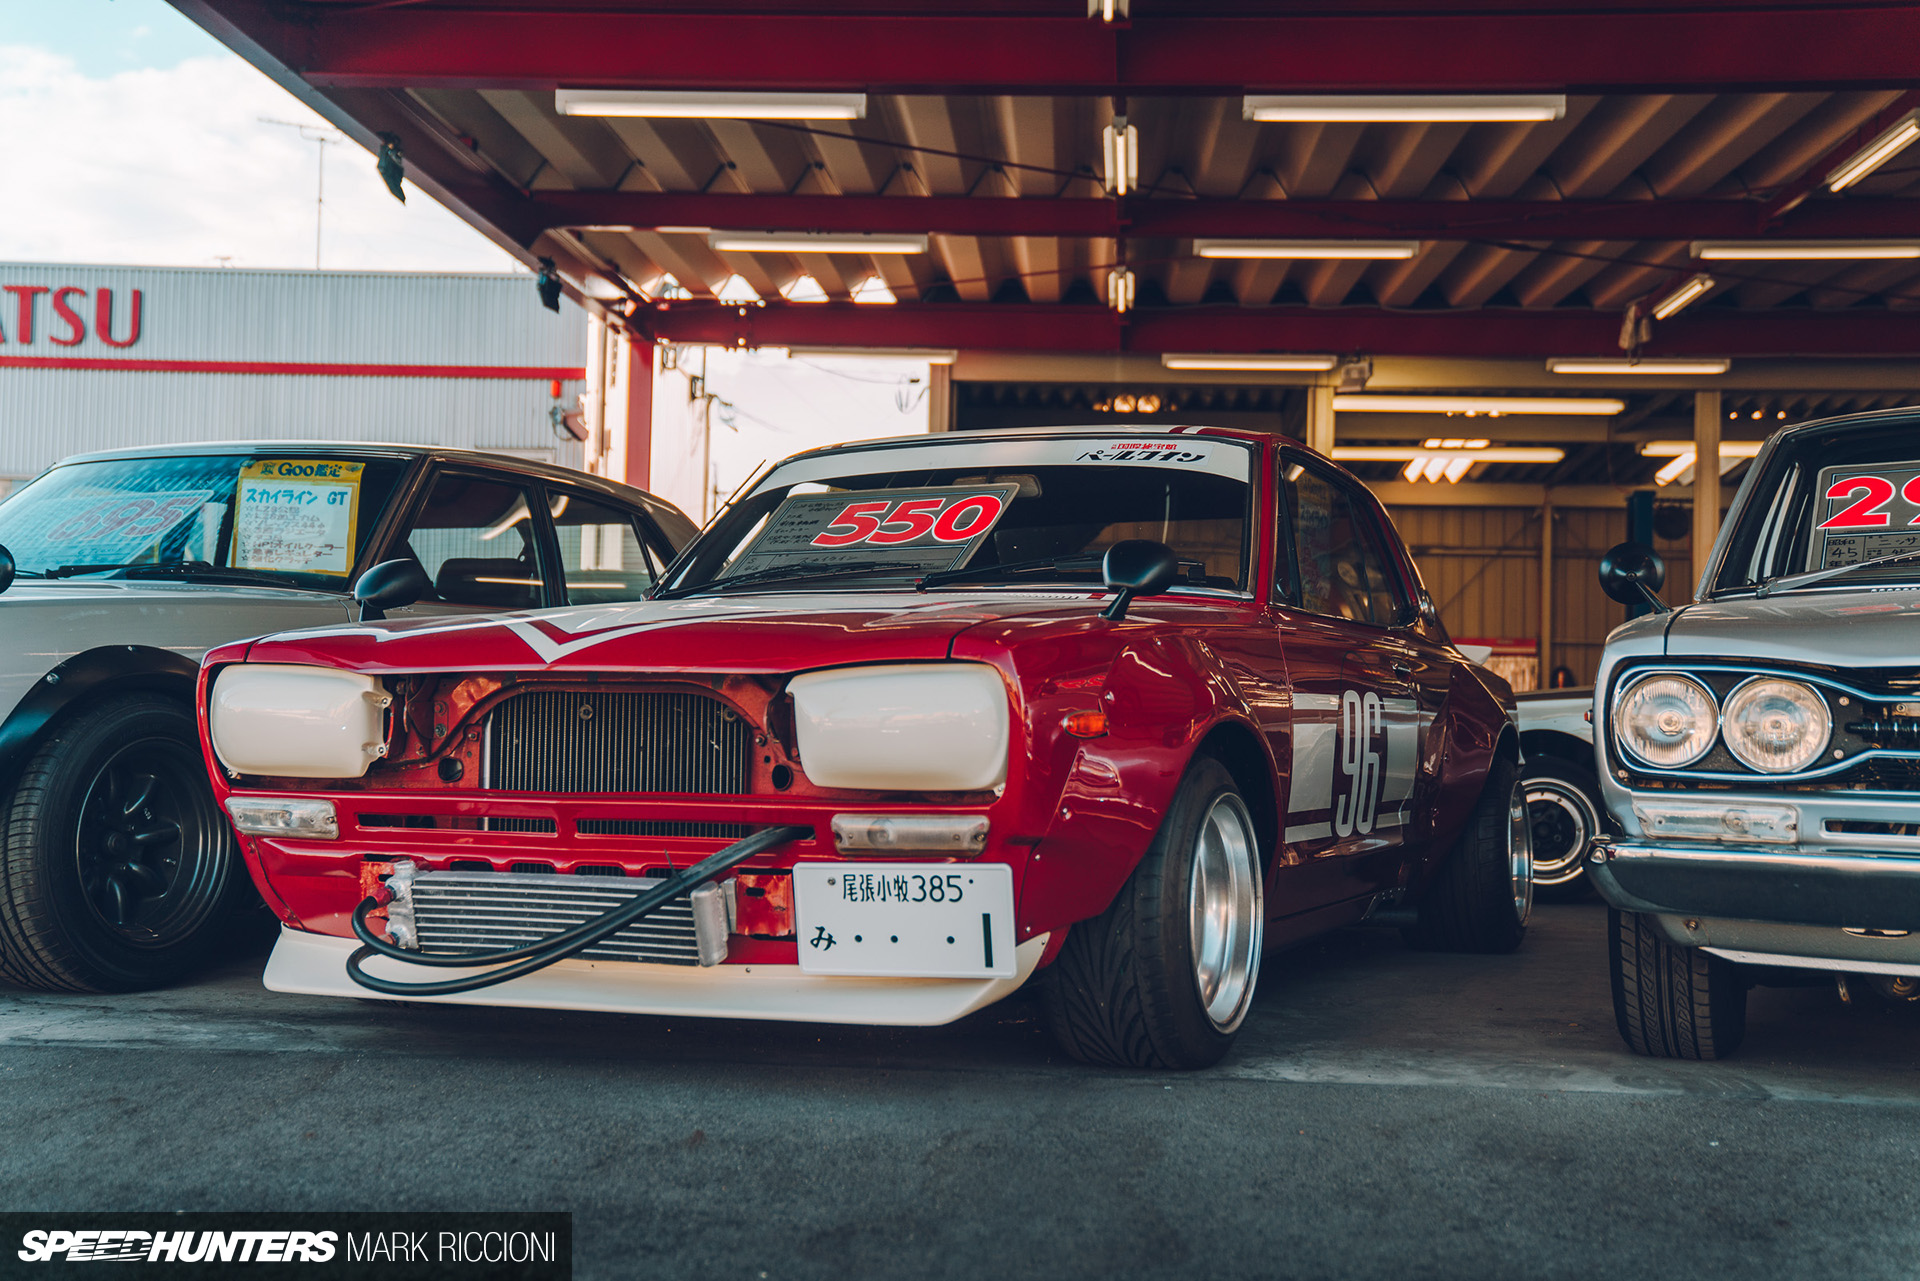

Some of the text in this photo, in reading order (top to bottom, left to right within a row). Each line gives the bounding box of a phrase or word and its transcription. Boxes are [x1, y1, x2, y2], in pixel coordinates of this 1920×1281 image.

[0, 285, 142, 349] TSU
[46, 496, 203, 541] 695
[245, 487, 349, 506] スカイライン GT
[1816, 475, 1920, 529] 2
[810, 495, 1003, 547] 550
[1832, 547, 1858, 558] 45
[1335, 689, 1382, 838] 96
[810, 926, 837, 951] み
